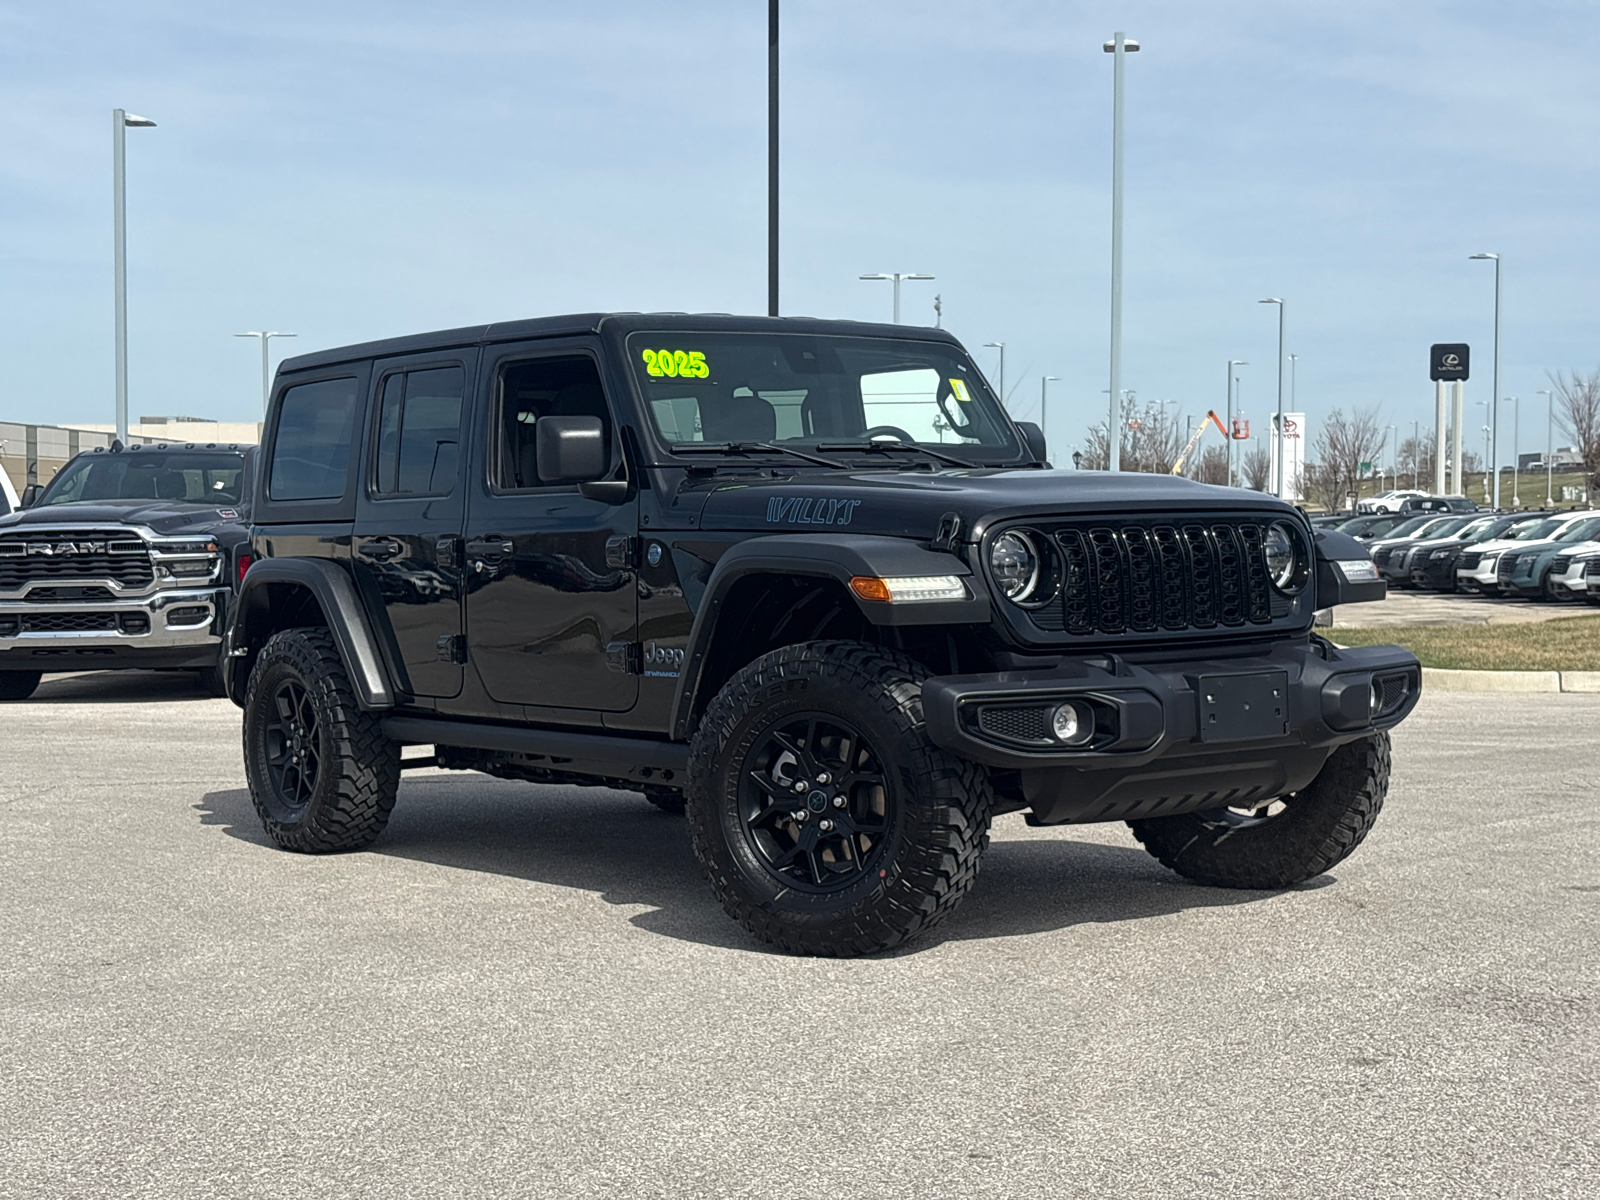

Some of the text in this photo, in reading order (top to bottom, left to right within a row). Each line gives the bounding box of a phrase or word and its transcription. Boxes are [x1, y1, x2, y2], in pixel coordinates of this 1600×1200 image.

[642, 349, 710, 378] 2025
[766, 497, 862, 525] WILLYS
[27, 541, 106, 556] RAM
[644, 642, 685, 669] Jeep
